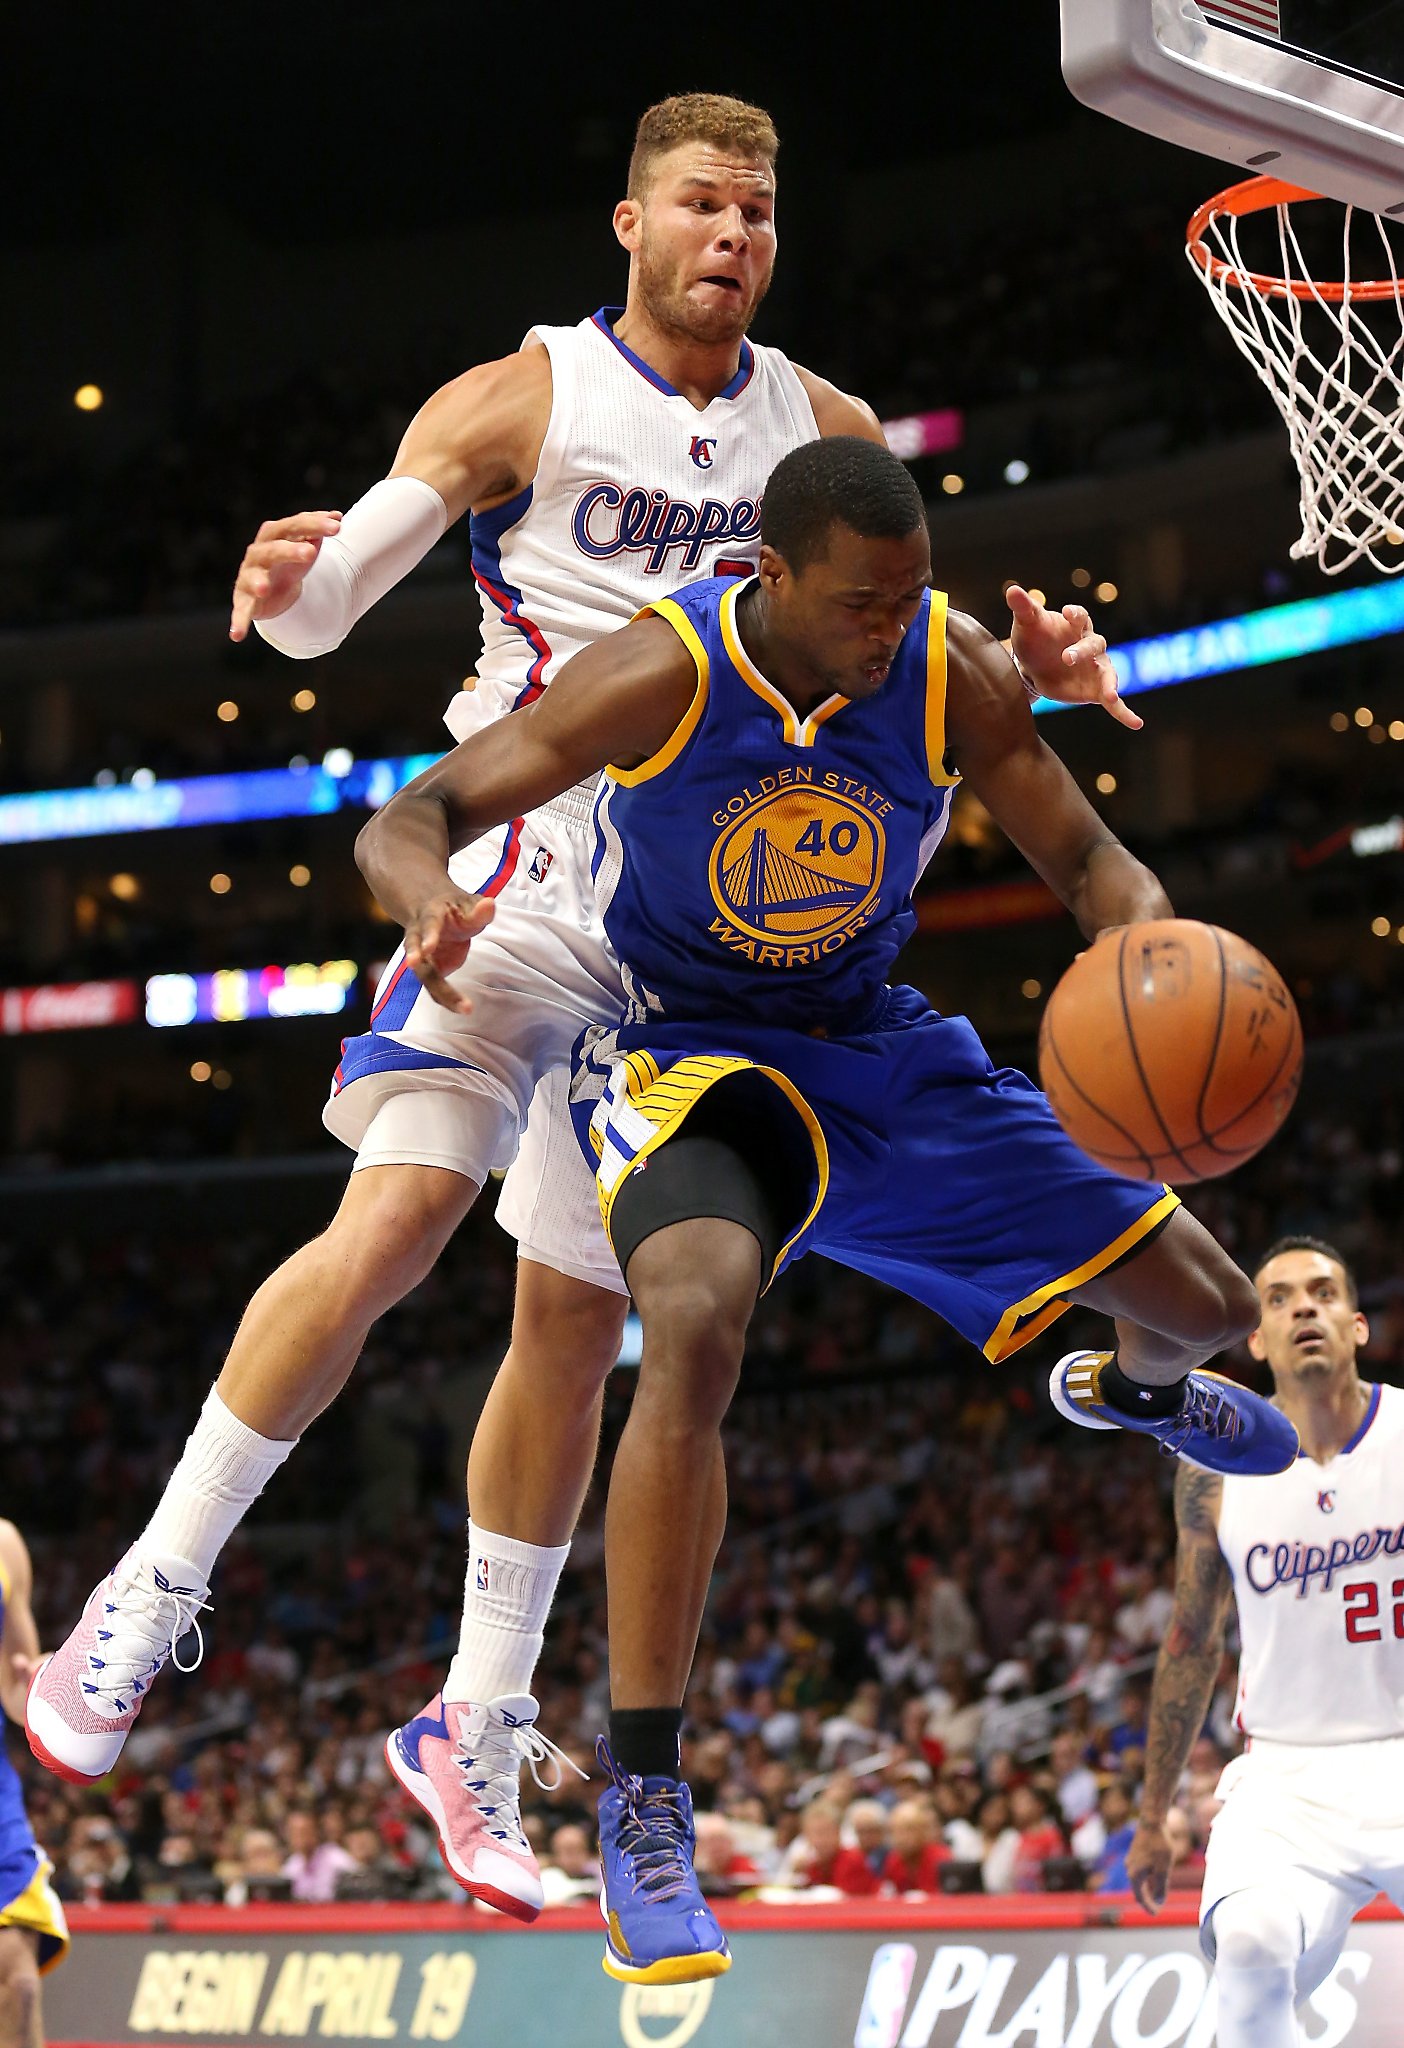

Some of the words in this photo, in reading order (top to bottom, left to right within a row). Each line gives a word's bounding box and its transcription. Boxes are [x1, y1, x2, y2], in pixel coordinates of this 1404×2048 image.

[571, 481, 764, 574] Clippe
[712, 766, 813, 827] GOLDEN
[822, 772, 895, 818] STATE
[794, 818, 860, 857] 40
[707, 897, 881, 968] WARRIORS
[128, 1951, 270, 2034] BEGIN
[259, 1951, 403, 2039] APRIL
[408, 1951, 477, 2041] 19
[902, 1946, 1373, 2048] PLAYOS
